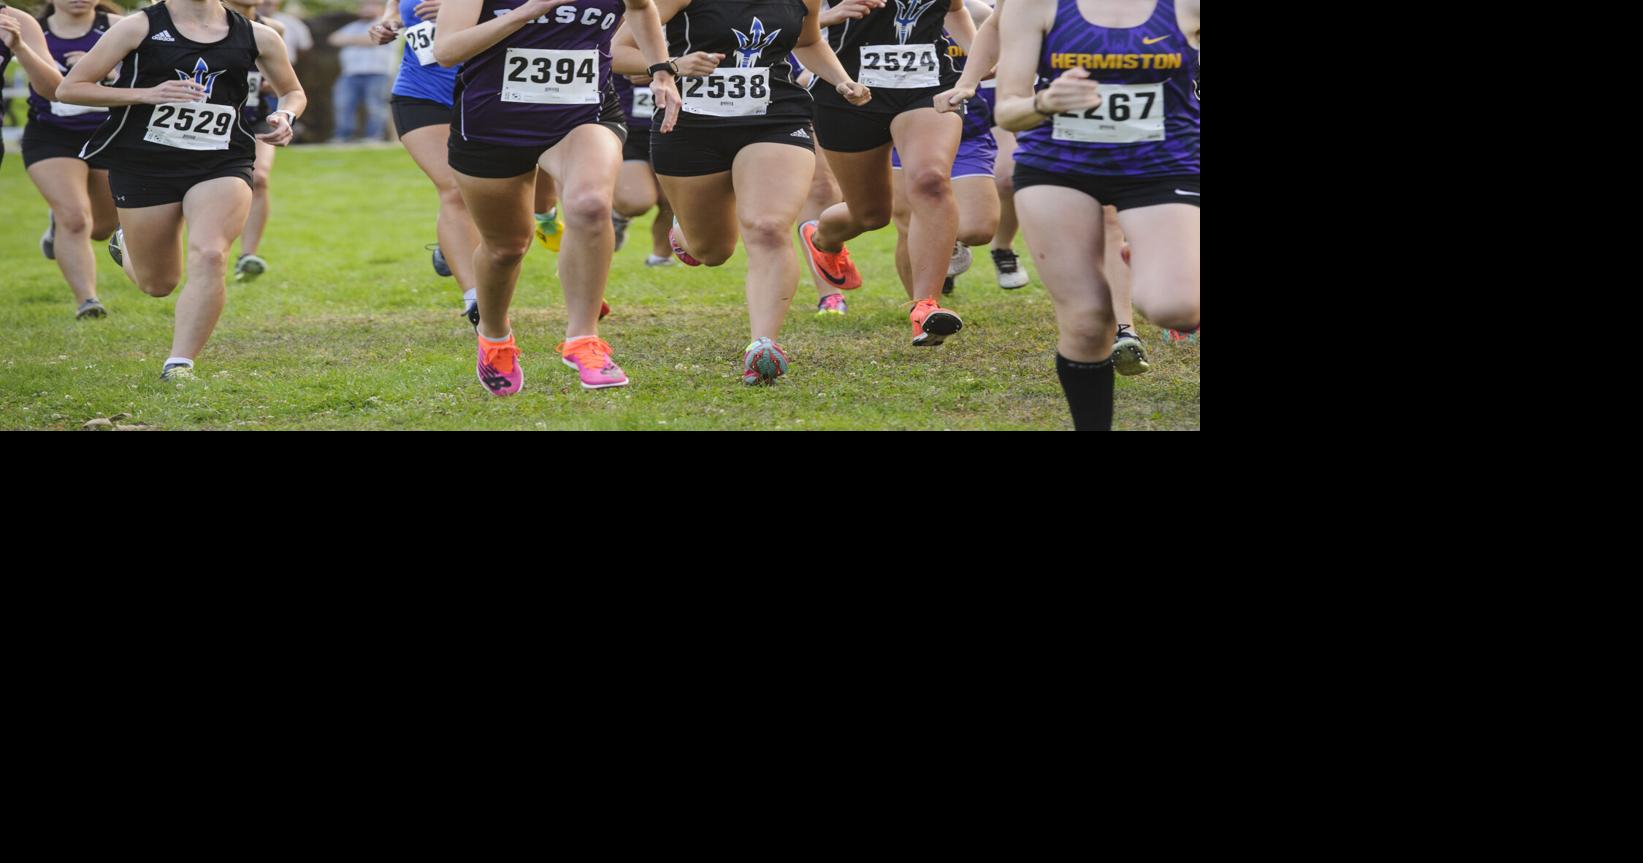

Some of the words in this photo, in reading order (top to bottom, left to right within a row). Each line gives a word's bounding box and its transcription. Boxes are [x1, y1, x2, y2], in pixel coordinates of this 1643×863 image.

[508, 56, 596, 84] 2394
[863, 51, 936, 72] 2524
[1050, 52, 1182, 69] HERMISTON
[686, 75, 766, 98] 2538
[1058, 91, 1156, 121] 267
[152, 105, 232, 136] 2529
